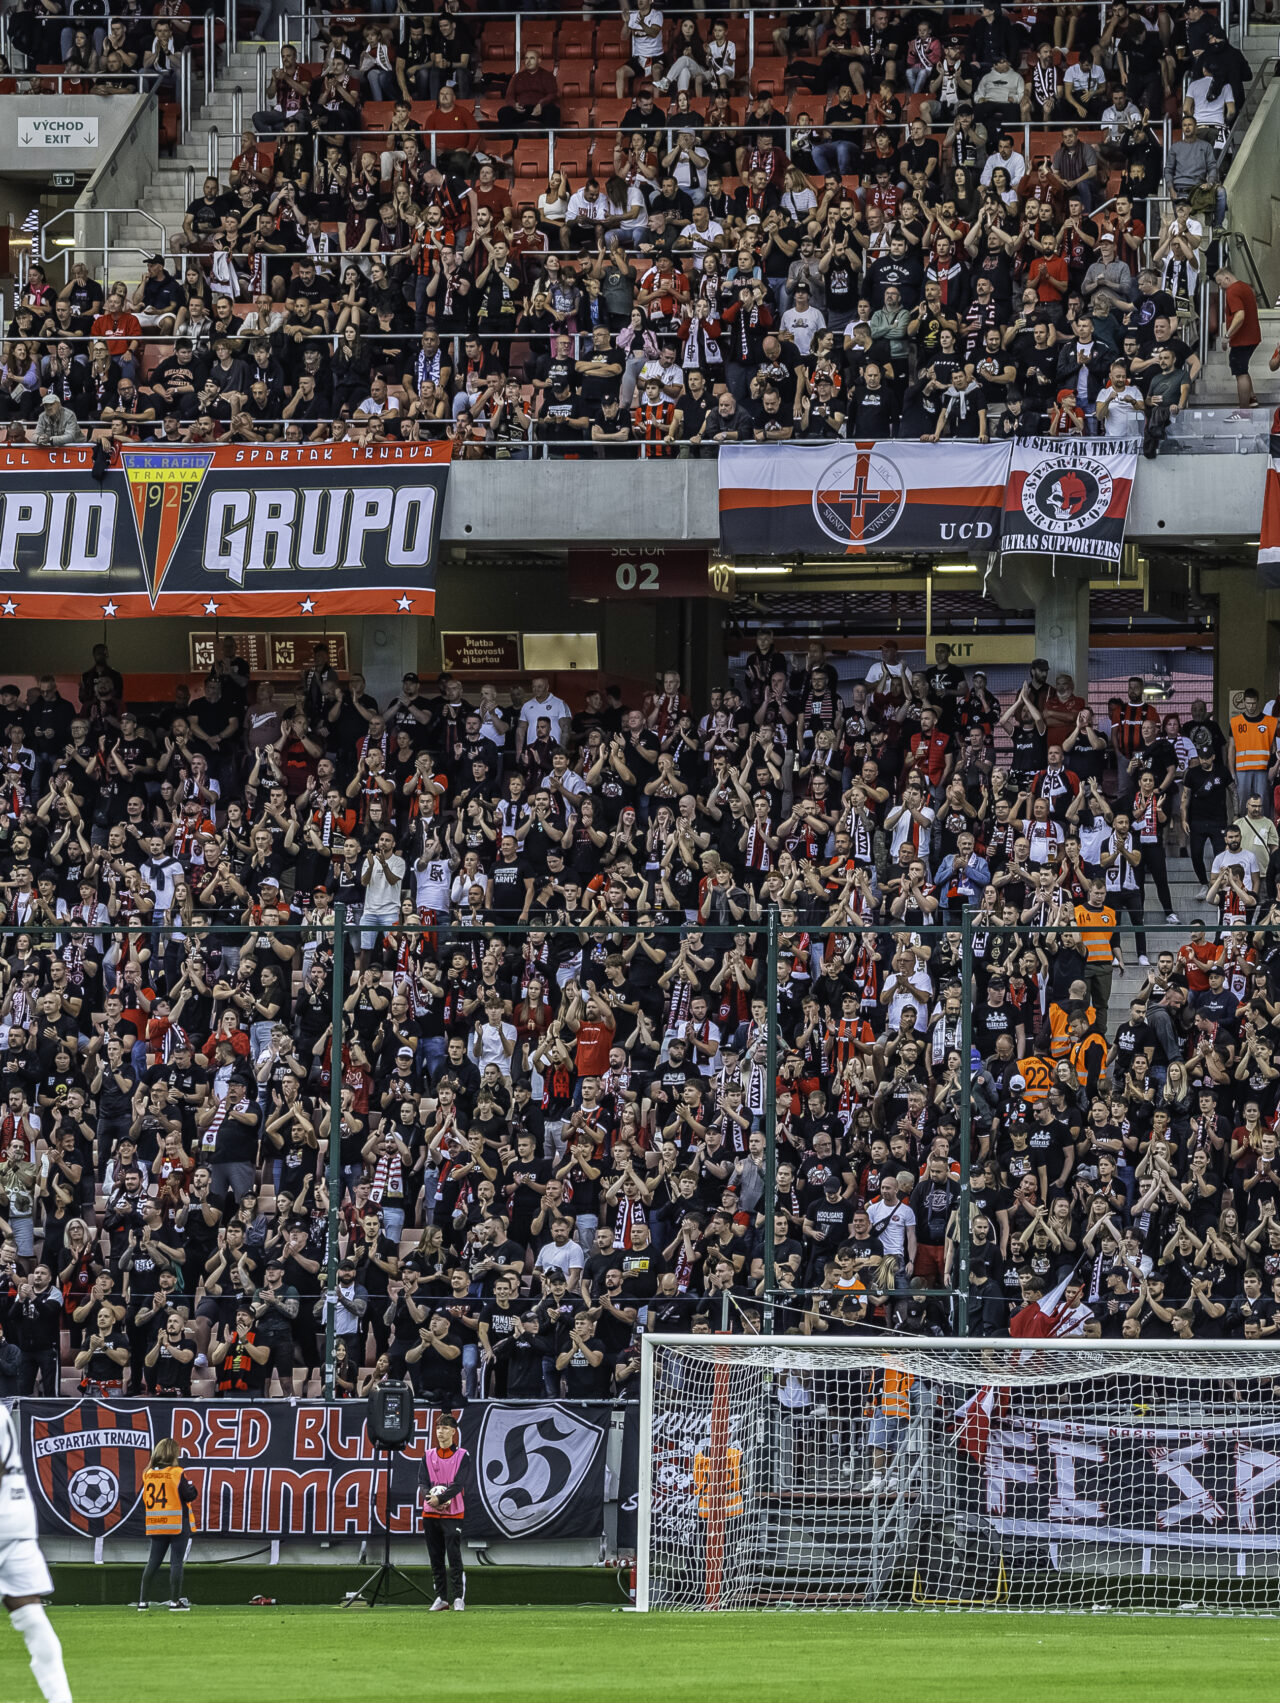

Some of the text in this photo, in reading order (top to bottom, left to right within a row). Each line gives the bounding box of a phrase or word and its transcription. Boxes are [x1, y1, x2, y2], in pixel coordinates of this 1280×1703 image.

[33, 119, 83, 132] VÝCHOD
[45, 134, 70, 144] EXIT
[161, 457, 206, 468] RAPID
[235, 446, 433, 462] SPARTAK TRNAVA
[133, 471, 198, 480] TRNAVA
[136, 484, 194, 508] 1925
[823, 508, 845, 532] SIGNO
[869, 507, 896, 533] VINCES
[202, 484, 438, 588] GRUPO
[939, 522, 993, 540] UCD
[1001, 534, 1120, 558] ULTRAS SUPPORTERS
[615, 563, 660, 590] 02
[713, 562, 729, 593] 02
[465, 638, 494, 647] Platba
[949, 643, 974, 657] XIT
[1238, 724, 1248, 734] 80
[1078, 913, 1091, 925] 114
[37, 1431, 148, 1455] FC SPARTAK TRNAVA
[171, 1407, 272, 1460] RED
[146, 1482, 168, 1510] 34
